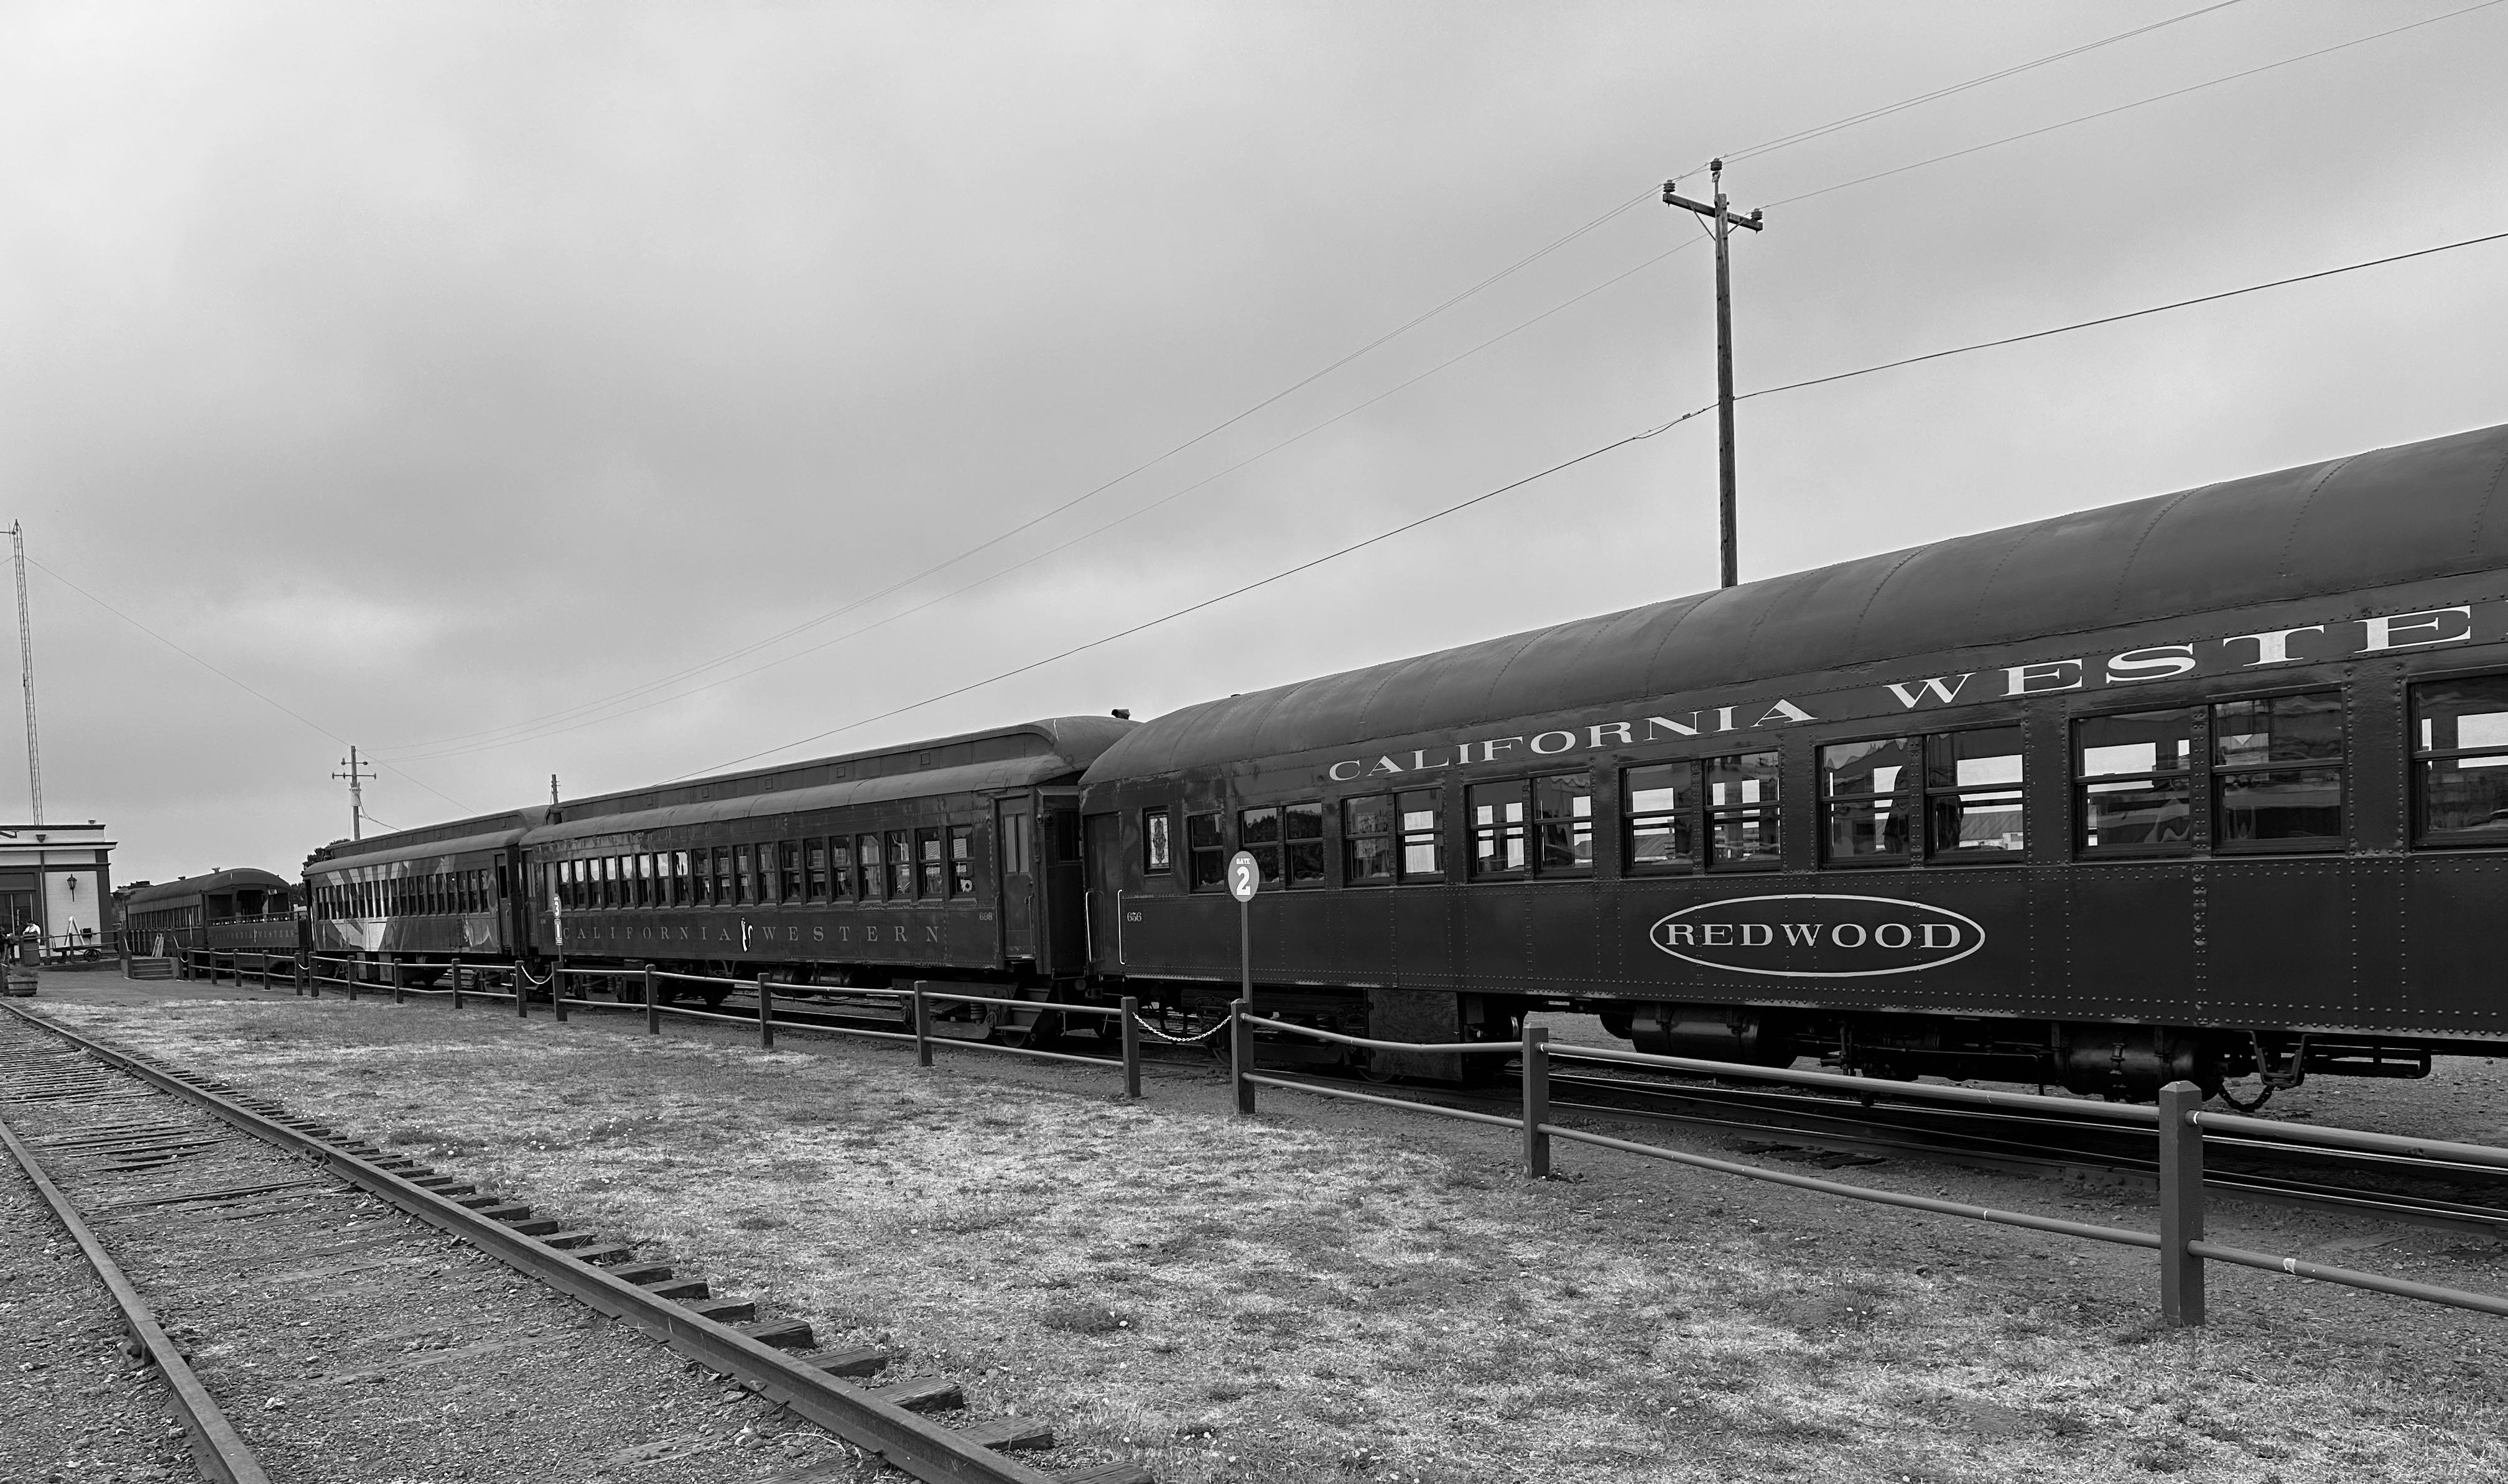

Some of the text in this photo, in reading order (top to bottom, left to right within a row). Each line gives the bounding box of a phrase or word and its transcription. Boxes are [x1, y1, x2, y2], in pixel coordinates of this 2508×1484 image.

[1328, 600, 2508, 782] CALIFORNIA WESTE
[1237, 866, 1251, 896] 2
[554, 901, 560, 917] 3
[979, 912, 993, 921] 698
[1126, 912, 1142, 922] 656
[563, 925, 939, 943] CALIFORNIA WESTERN
[1665, 924, 1961, 948] REDWOOD
